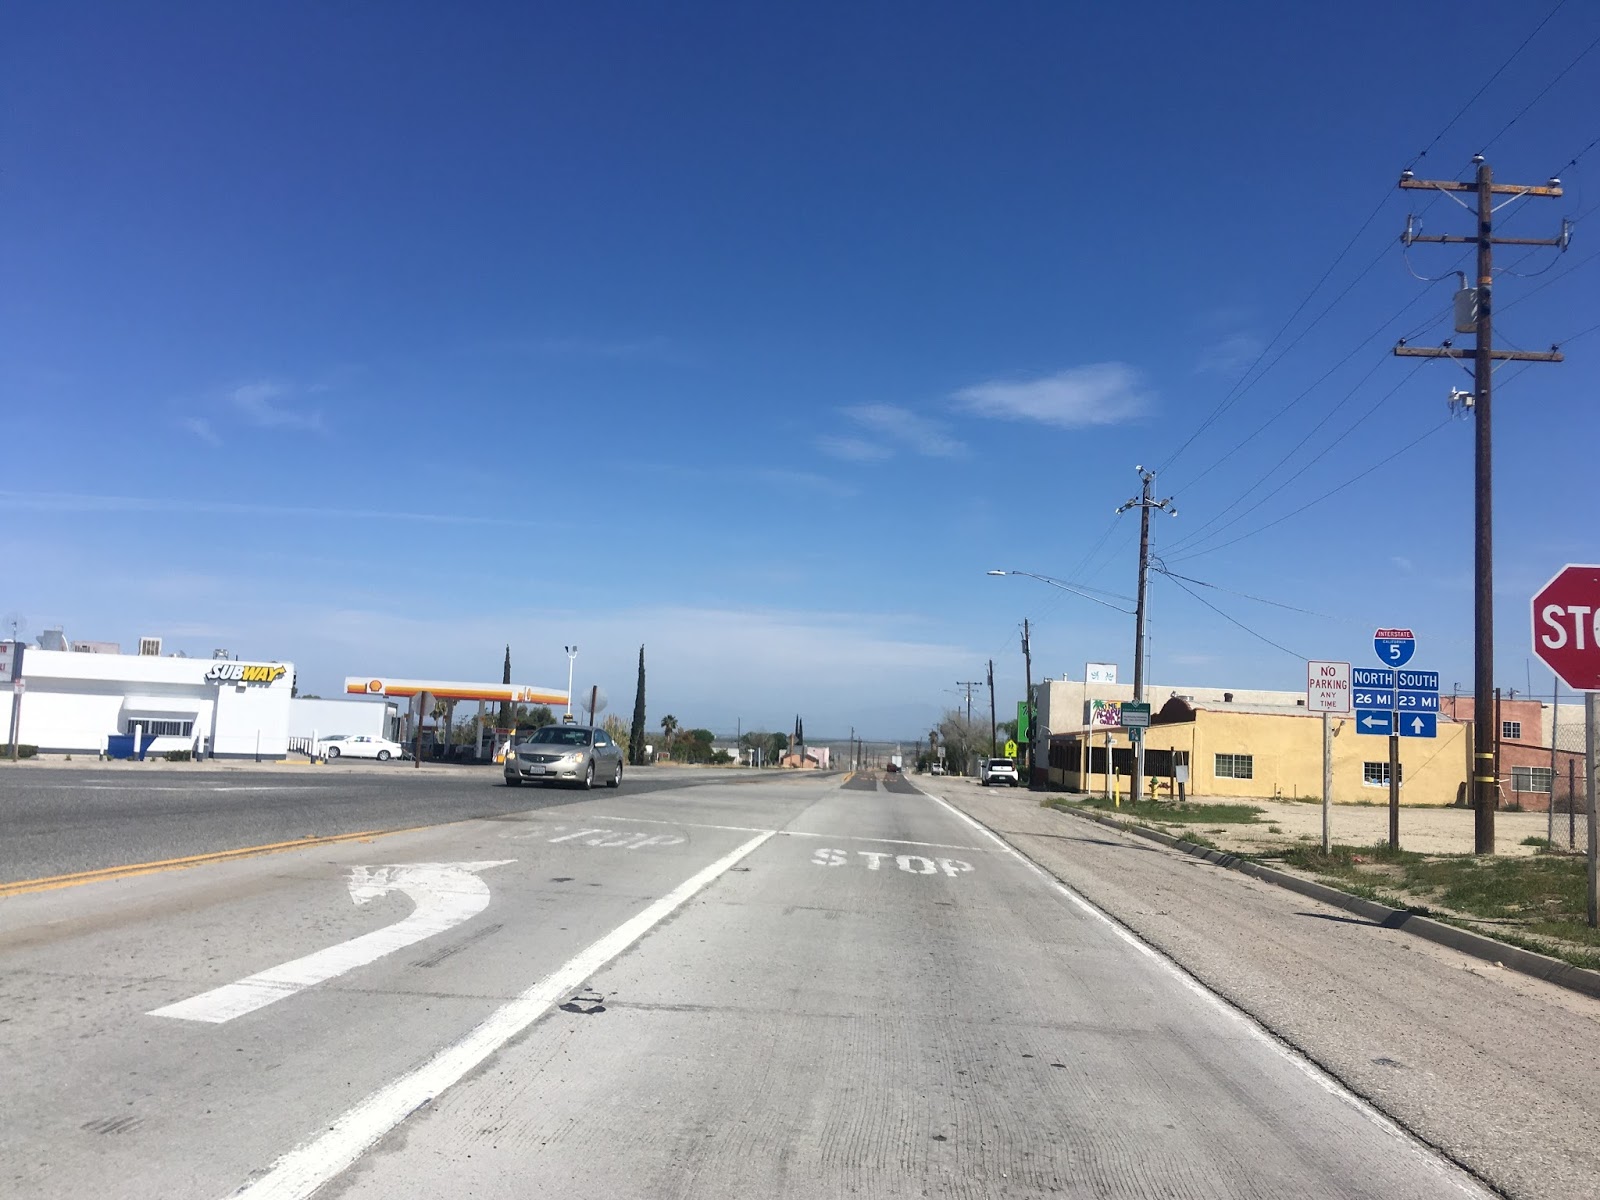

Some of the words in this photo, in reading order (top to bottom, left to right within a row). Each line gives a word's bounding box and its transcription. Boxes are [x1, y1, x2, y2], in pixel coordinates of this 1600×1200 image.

[1390, 644, 1401, 659] 5
[205, 664, 286, 682] SUBWAY
[1321, 666, 1336, 676] NO
[1354, 671, 1393, 685] NORTH
[1310, 679, 1347, 690] PARKING
[1399, 673, 1437, 687] SOUTH
[1355, 694, 1372, 704] 26
[1376, 695, 1391, 705] MI
[1398, 696, 1416, 706] 23
[1421, 697, 1437, 707] MI
[811, 848, 976, 877] STOP
